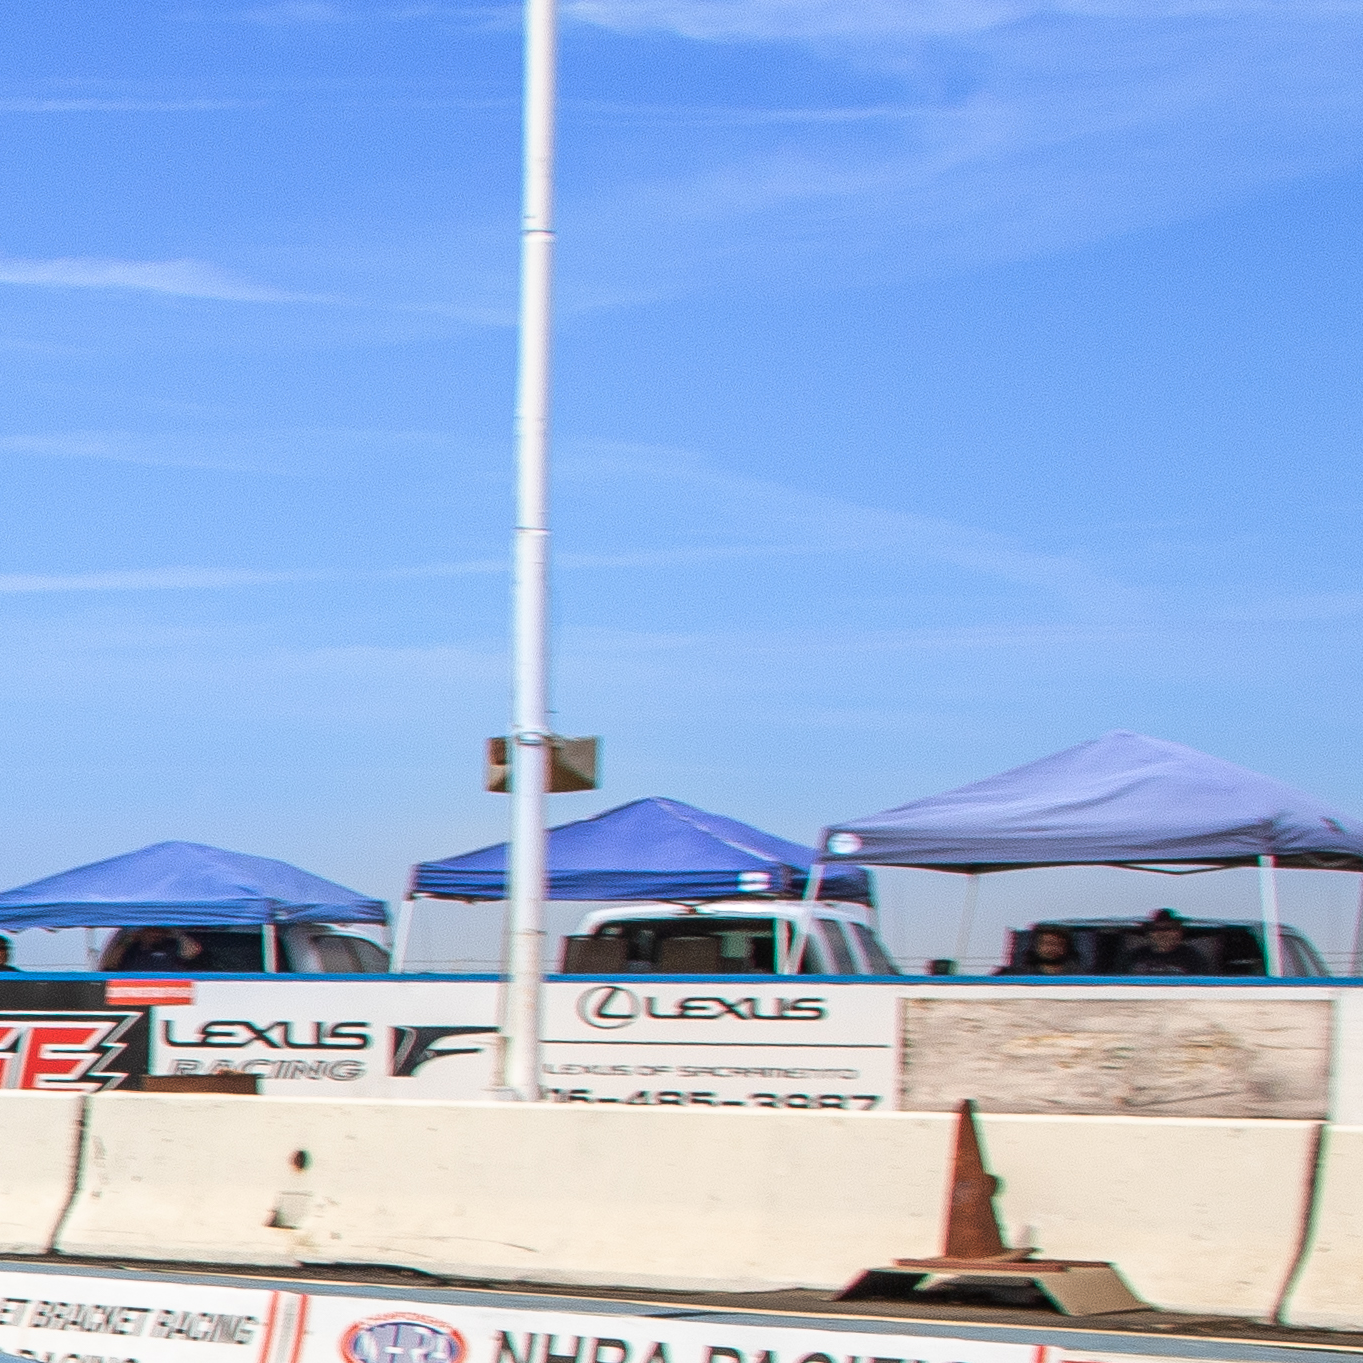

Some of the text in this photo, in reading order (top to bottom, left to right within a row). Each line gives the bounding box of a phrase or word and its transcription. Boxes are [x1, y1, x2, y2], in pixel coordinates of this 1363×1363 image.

[644, 996, 828, 1021] LEXUS
[161, 1019, 373, 1049] LEXUS
[169, 1058, 367, 1081] RACING
[541, 1063, 633, 1076] LEXUS
[28, 1300, 153, 1337] BRACKET
[149, 1309, 259, 1345] RACING
